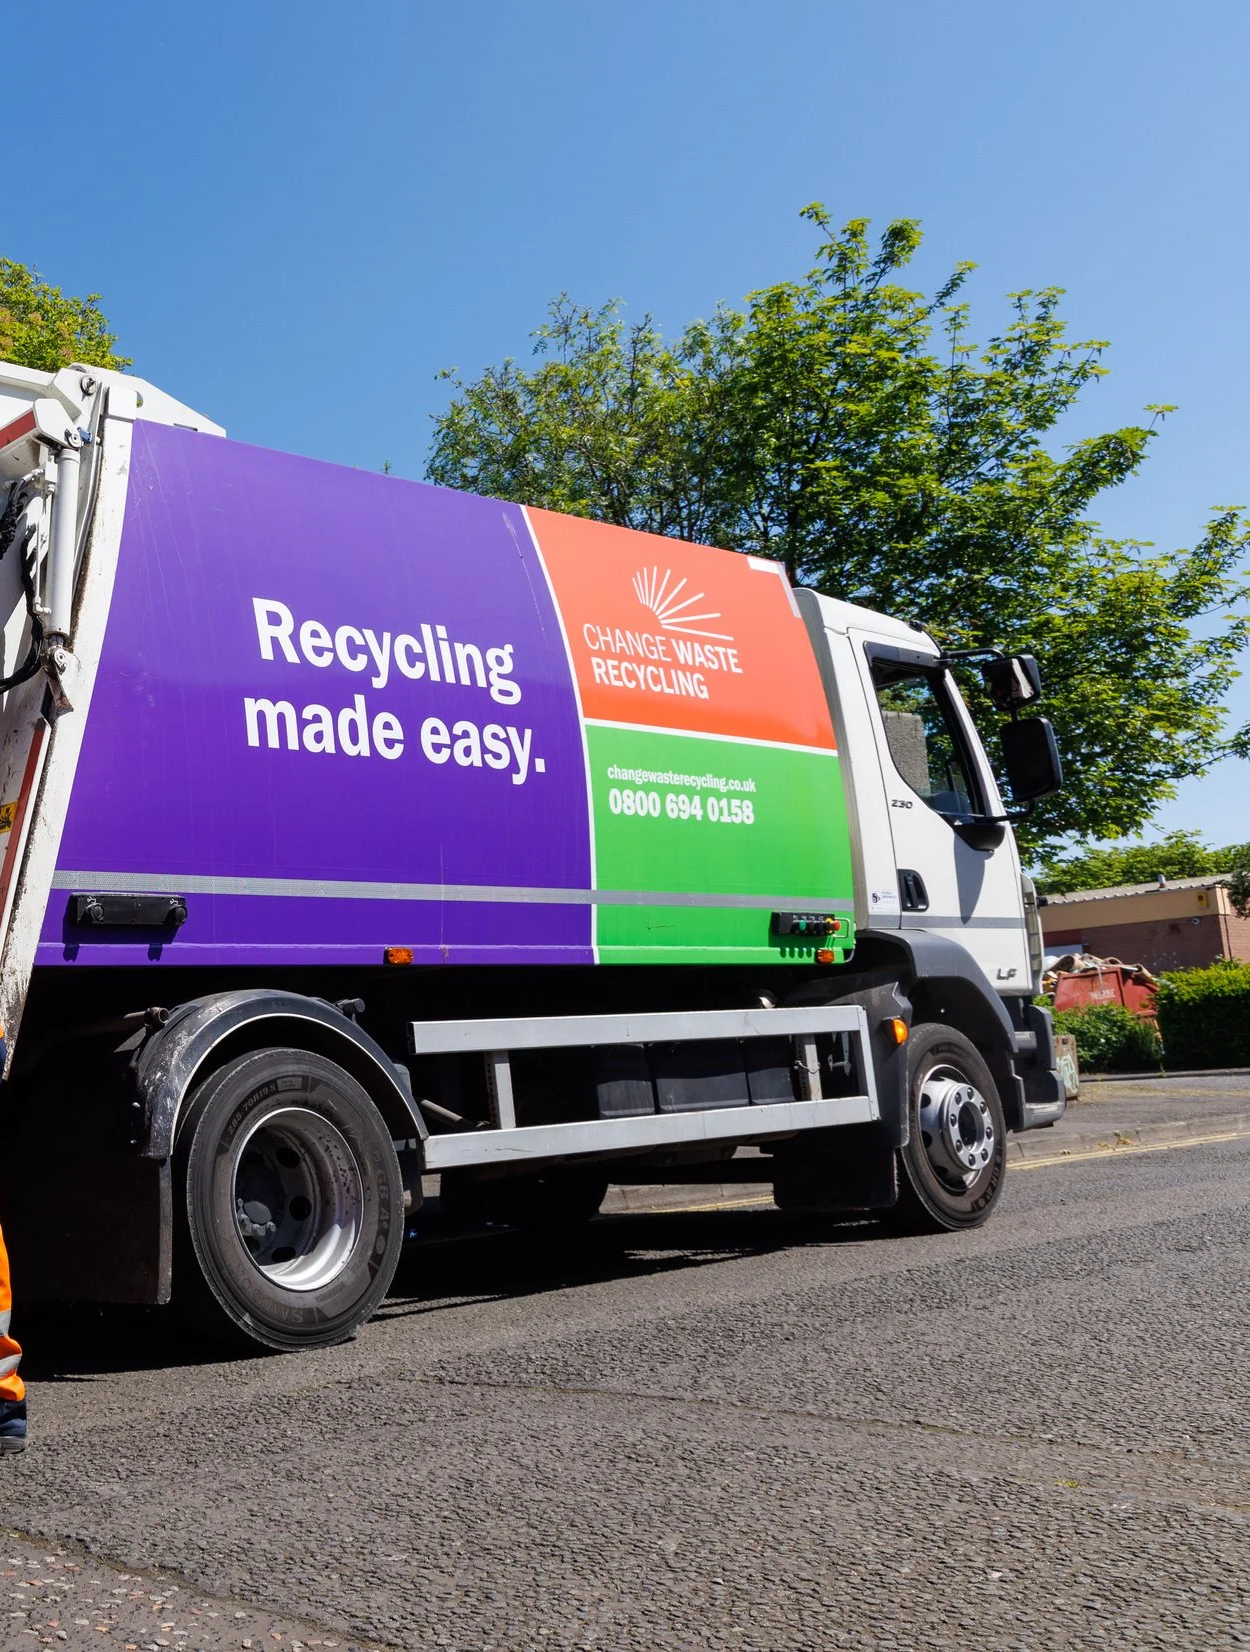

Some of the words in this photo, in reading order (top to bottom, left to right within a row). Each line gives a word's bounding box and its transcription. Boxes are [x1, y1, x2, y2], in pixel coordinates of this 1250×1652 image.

[252, 597, 522, 705] Recycling
[583, 623, 671, 662] CHANGE
[670, 638, 743, 674] WASTE
[591, 657, 709, 699] RECYCLING
[244, 694, 405, 760] made
[420, 715, 546, 785] easy.
[607, 765, 757, 793] changewasterecycling.co.uk
[609, 788, 661, 818] 0800
[665, 793, 703, 821] 694
[707, 797, 755, 825] 0158
[891, 799, 913, 810] 230
[996, 968, 1018, 980] LF
